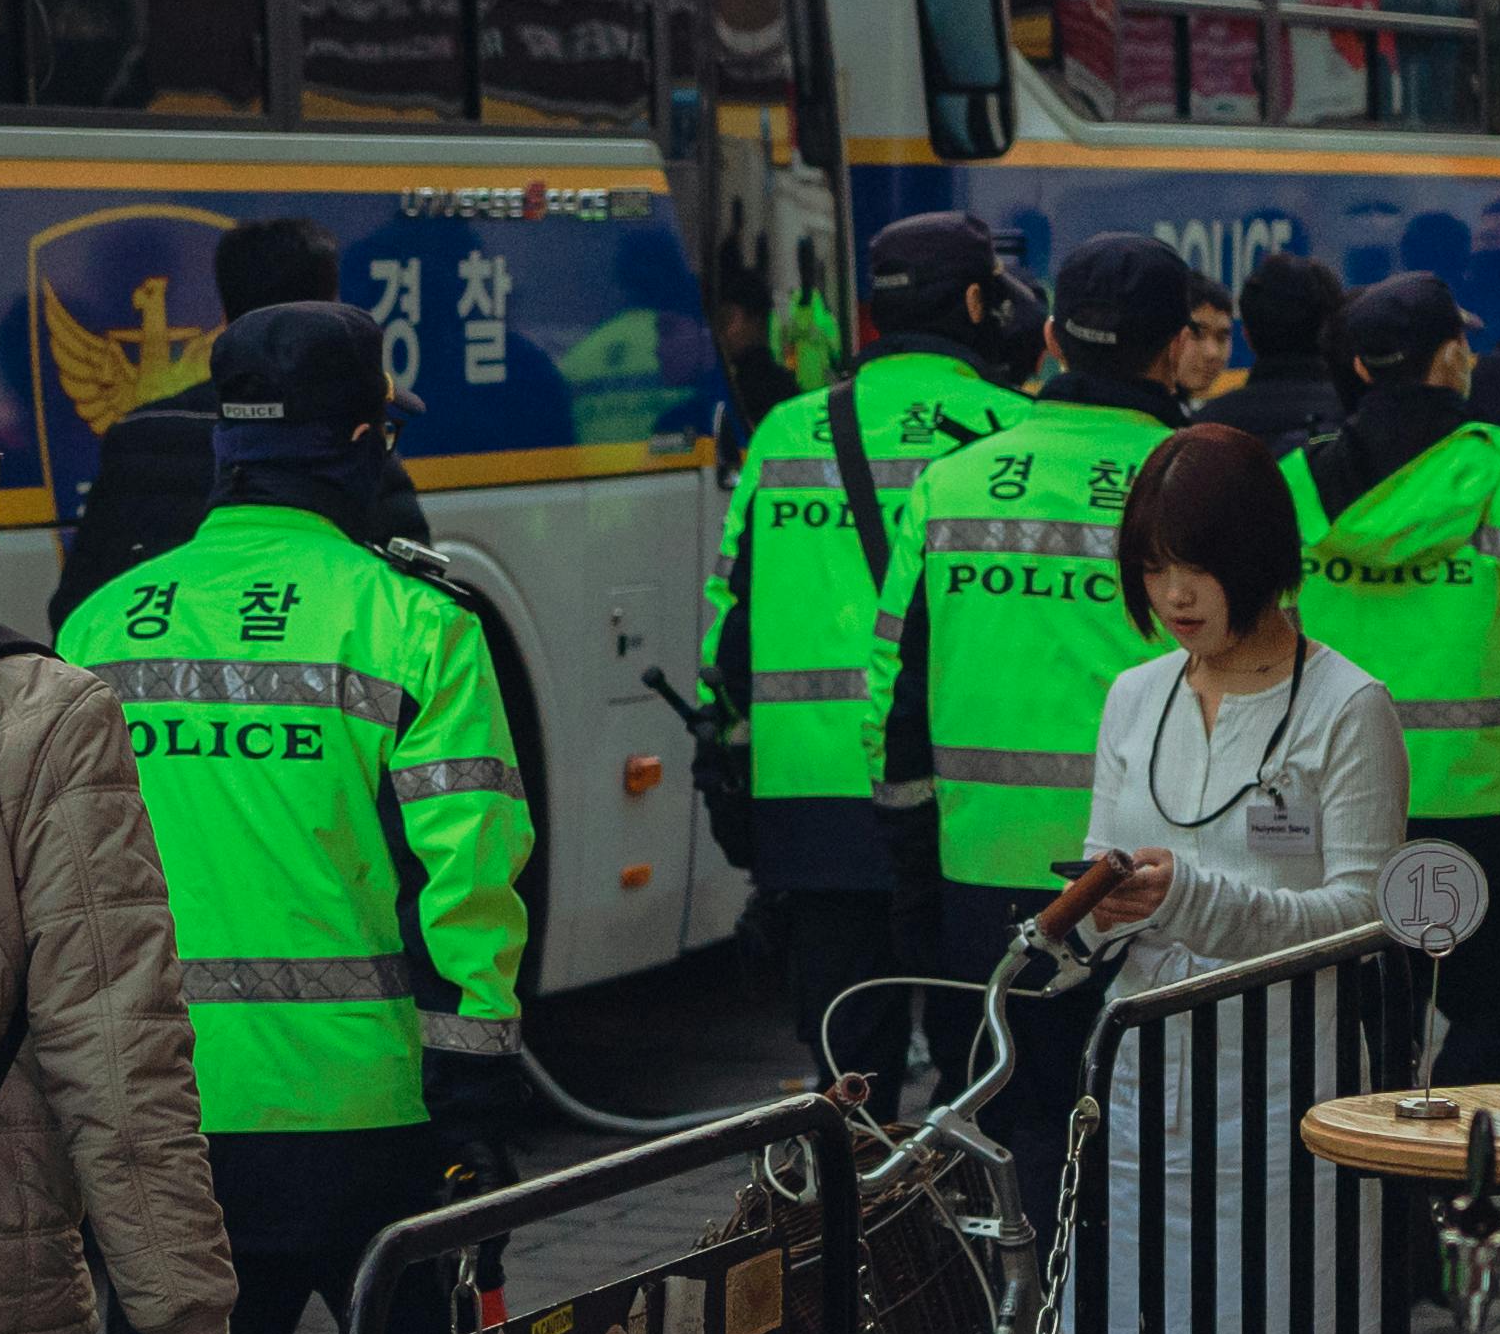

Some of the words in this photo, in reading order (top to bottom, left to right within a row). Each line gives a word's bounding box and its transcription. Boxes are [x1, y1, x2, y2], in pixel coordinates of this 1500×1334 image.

[225, 405, 277, 417] POLICE
[948, 565, 1117, 603] POLIC
[129, 719, 324, 760] OLICE
[1401, 863, 1460, 928] 15
